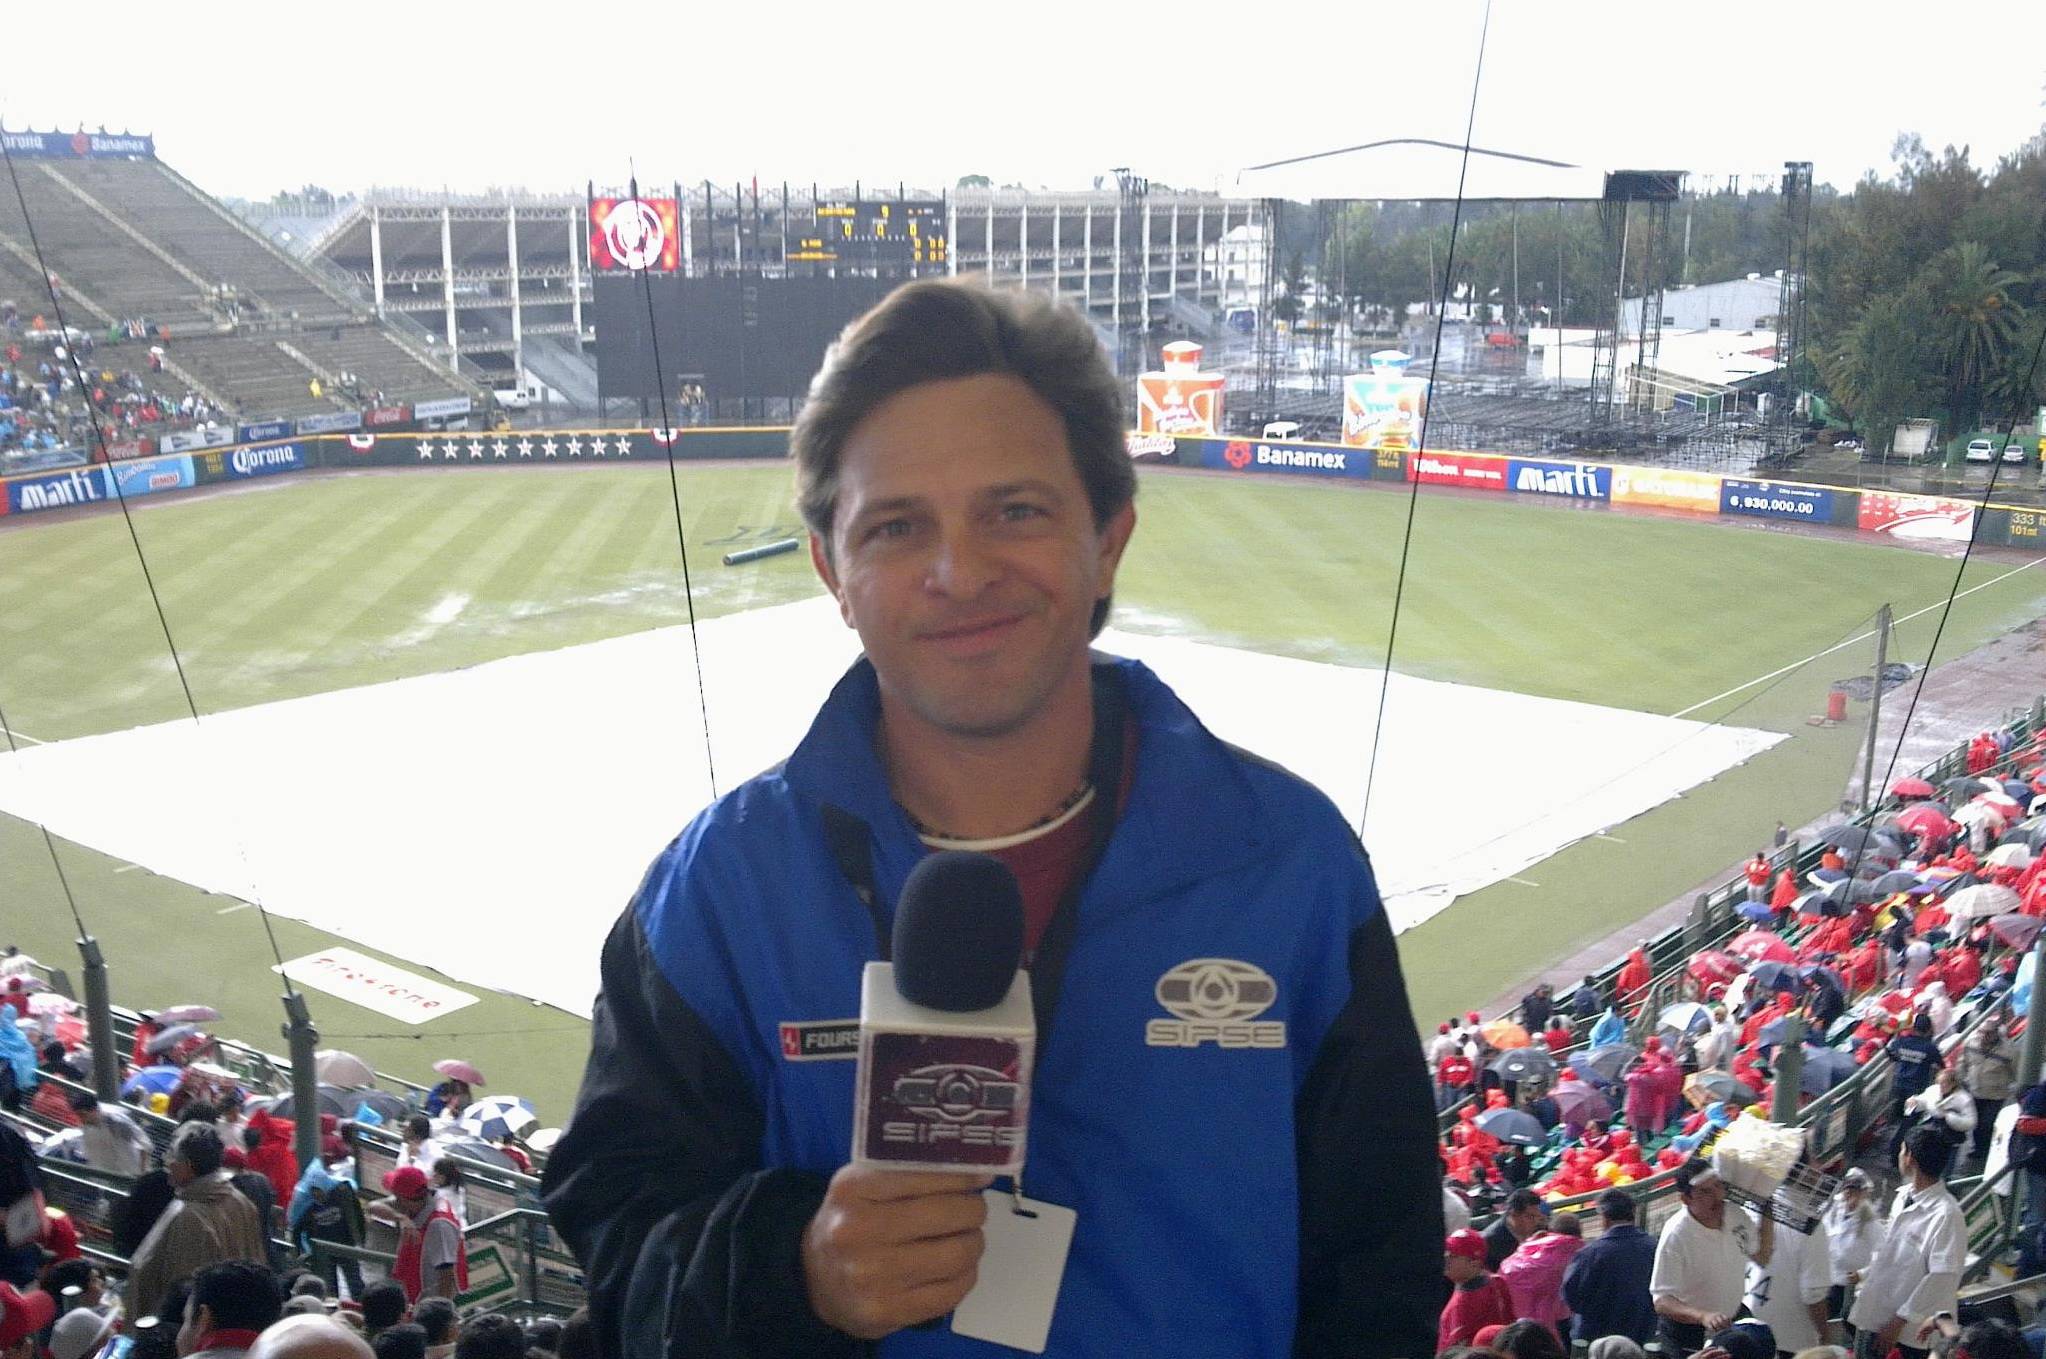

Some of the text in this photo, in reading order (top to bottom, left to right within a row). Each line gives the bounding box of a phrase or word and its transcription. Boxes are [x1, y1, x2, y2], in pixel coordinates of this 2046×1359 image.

[1, 134, 44, 149] orona
[91, 136, 146, 151] Banamex
[232, 445, 295, 475] Corona
[1257, 445, 1346, 469] Banamex
[2012, 512, 2034, 525] 333
[1149, 1021, 1284, 1046] SIPSE
[882, 1121, 1026, 1147] SIPSE
